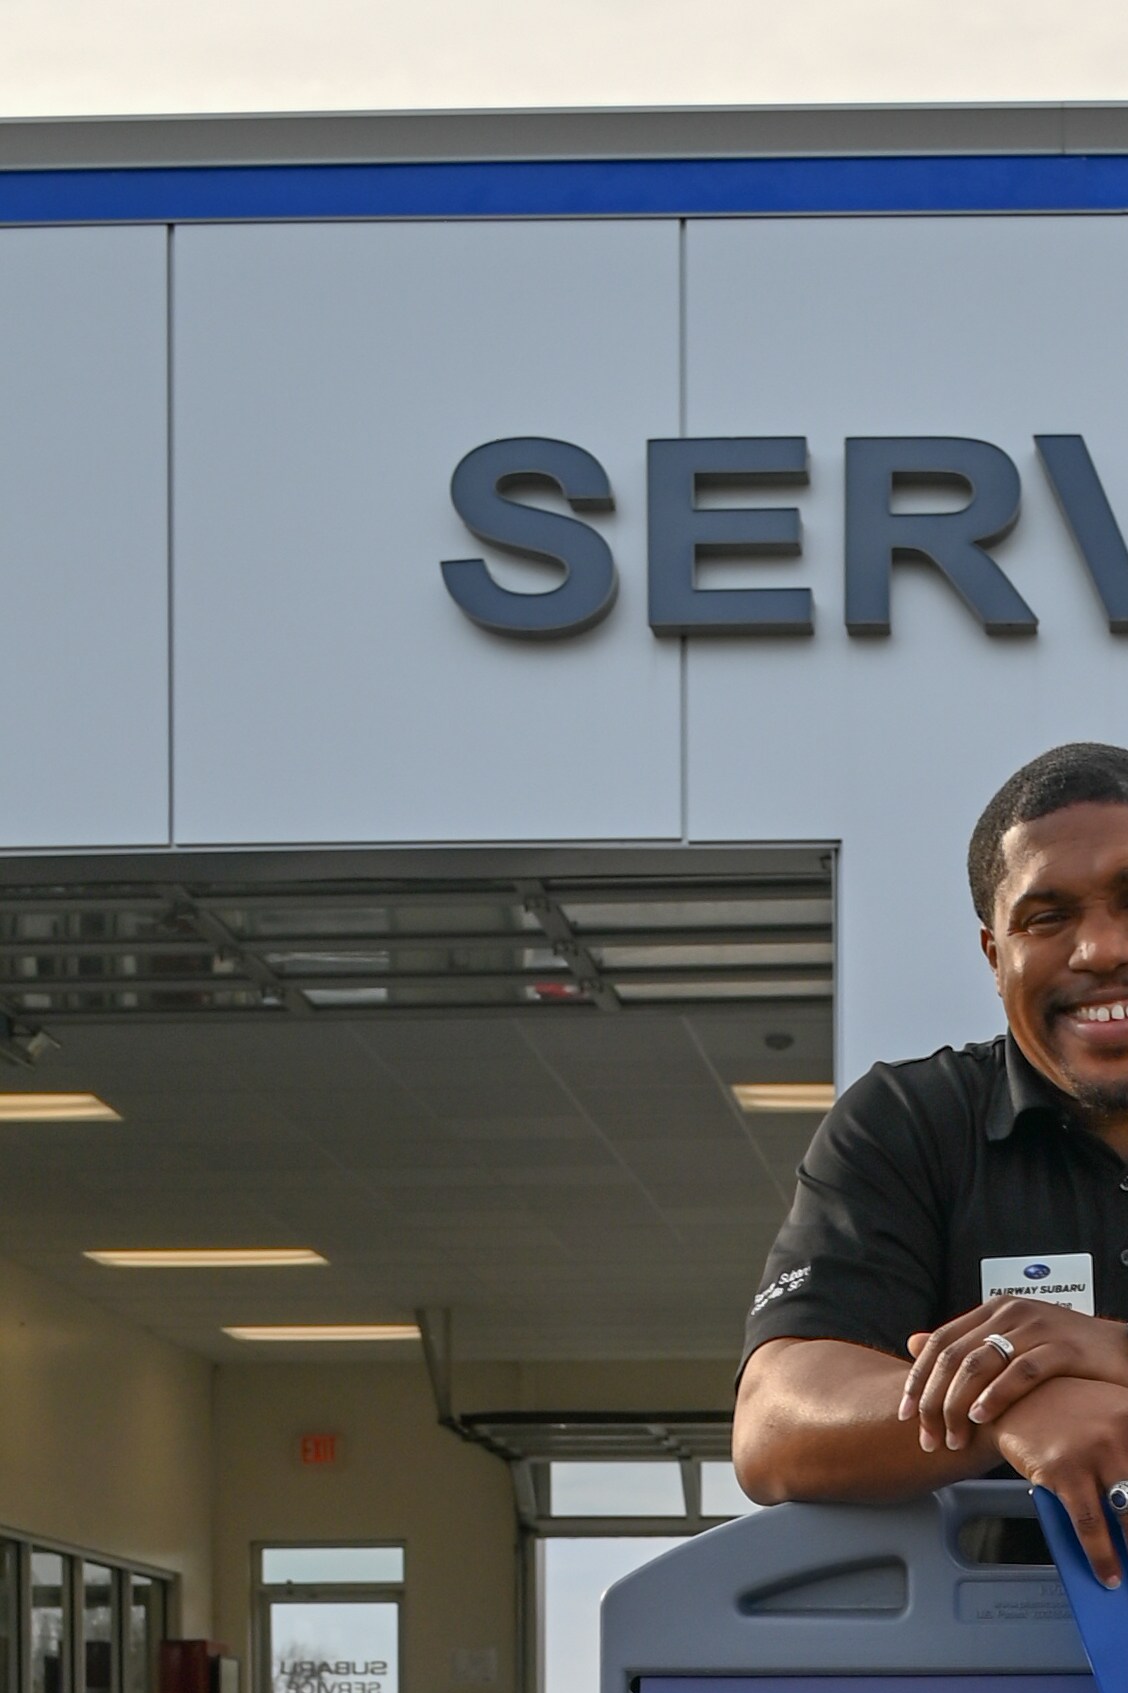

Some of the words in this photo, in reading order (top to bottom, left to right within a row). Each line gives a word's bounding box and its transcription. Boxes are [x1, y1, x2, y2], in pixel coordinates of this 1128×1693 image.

[989, 1286, 1038, 1297] FAIRWAY
[1039, 1283, 1086, 1294] SUBARU
[302, 1436, 336, 1463] EXIT
